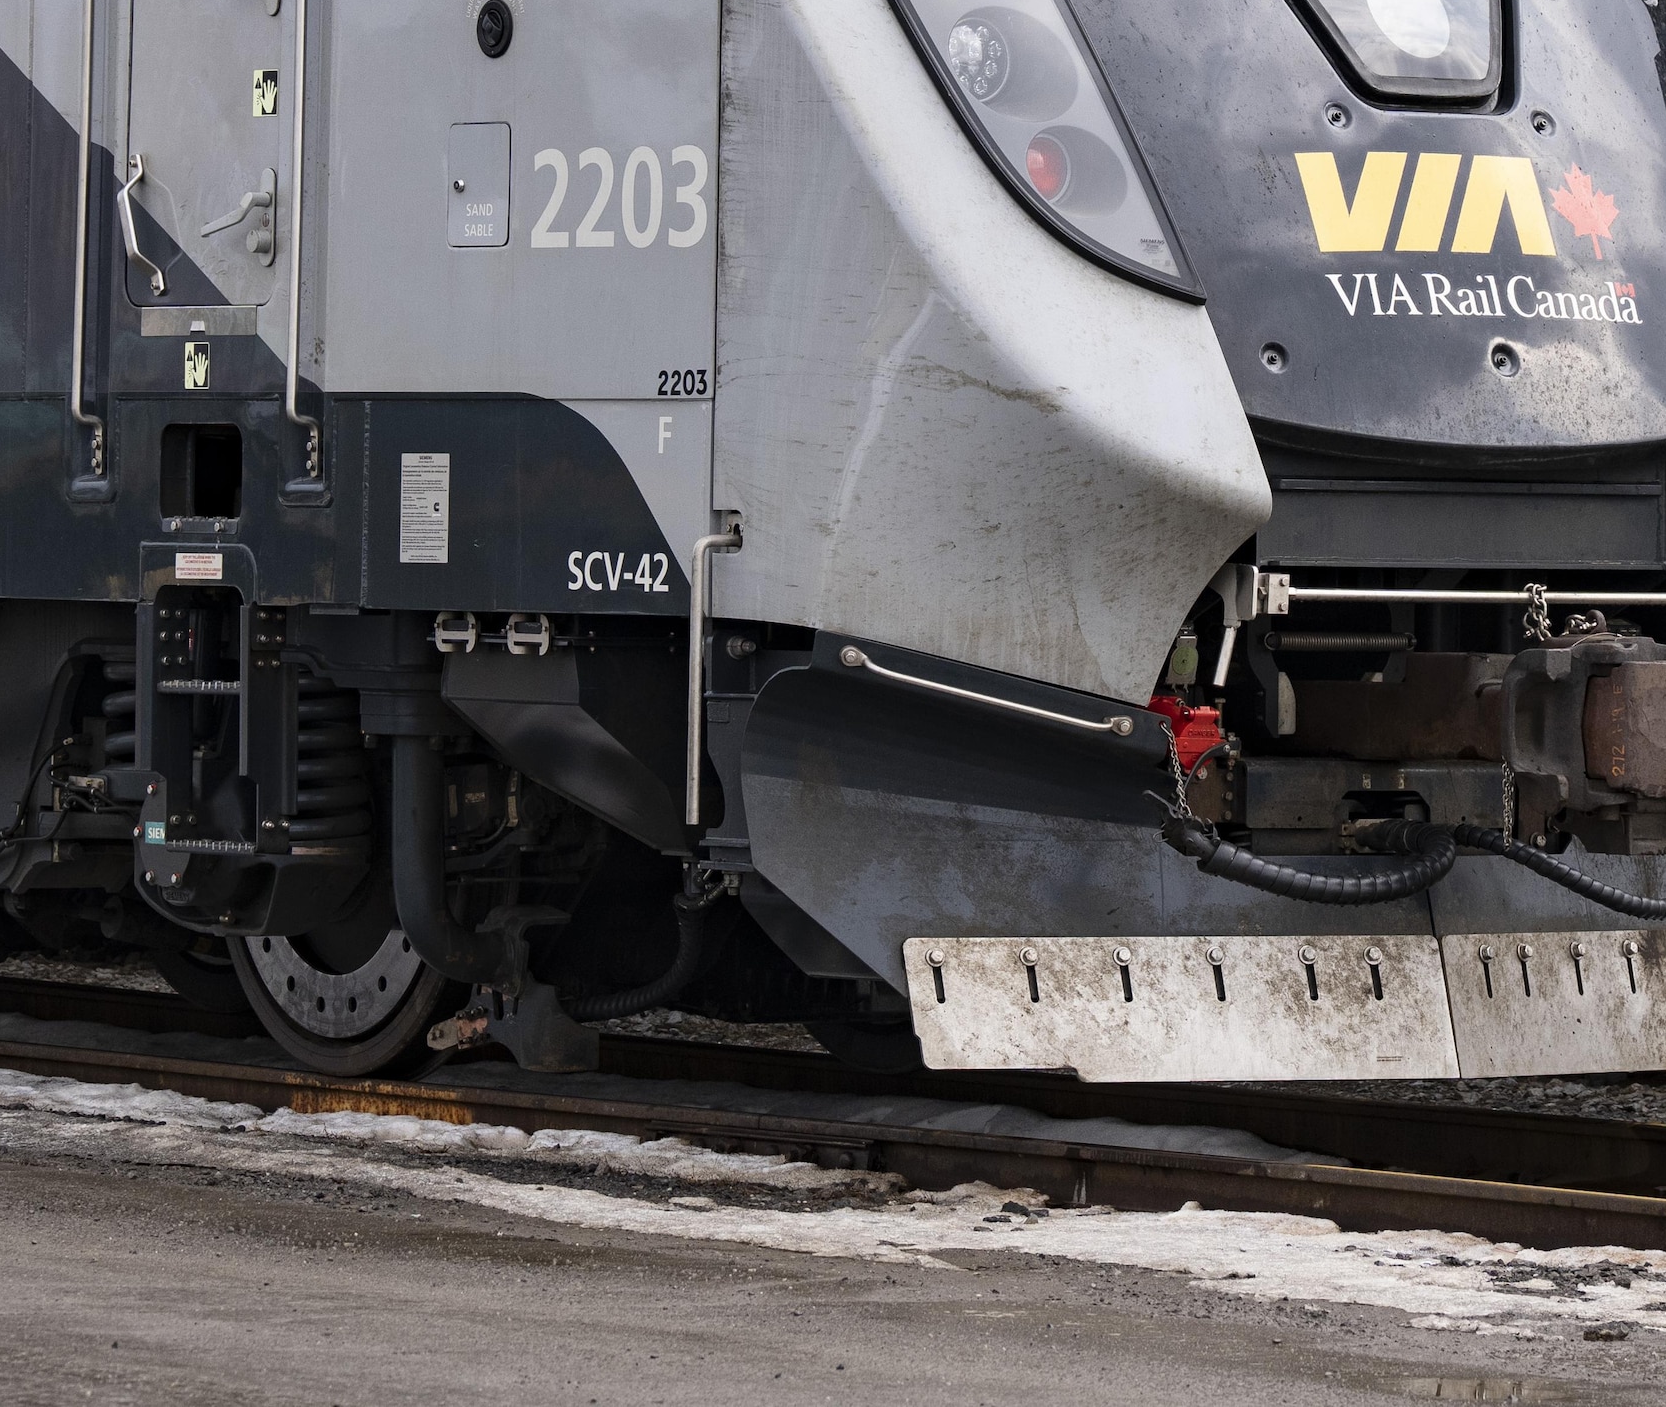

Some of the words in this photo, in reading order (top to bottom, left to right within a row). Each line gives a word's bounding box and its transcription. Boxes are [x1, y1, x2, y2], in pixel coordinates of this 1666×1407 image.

[466, 202, 494, 217] SAND
[530, 145, 709, 250] 2203
[1295, 151, 1557, 257] VIA
[463, 222, 494, 238] SABLE
[1325, 273, 1422, 317] VIA
[1423, 273, 1504, 319] Rail
[1506, 275, 1643, 325] Canada
[657, 369, 708, 396] 2203
[658, 416, 673, 454] F
[567, 550, 669, 594] SCV-42
